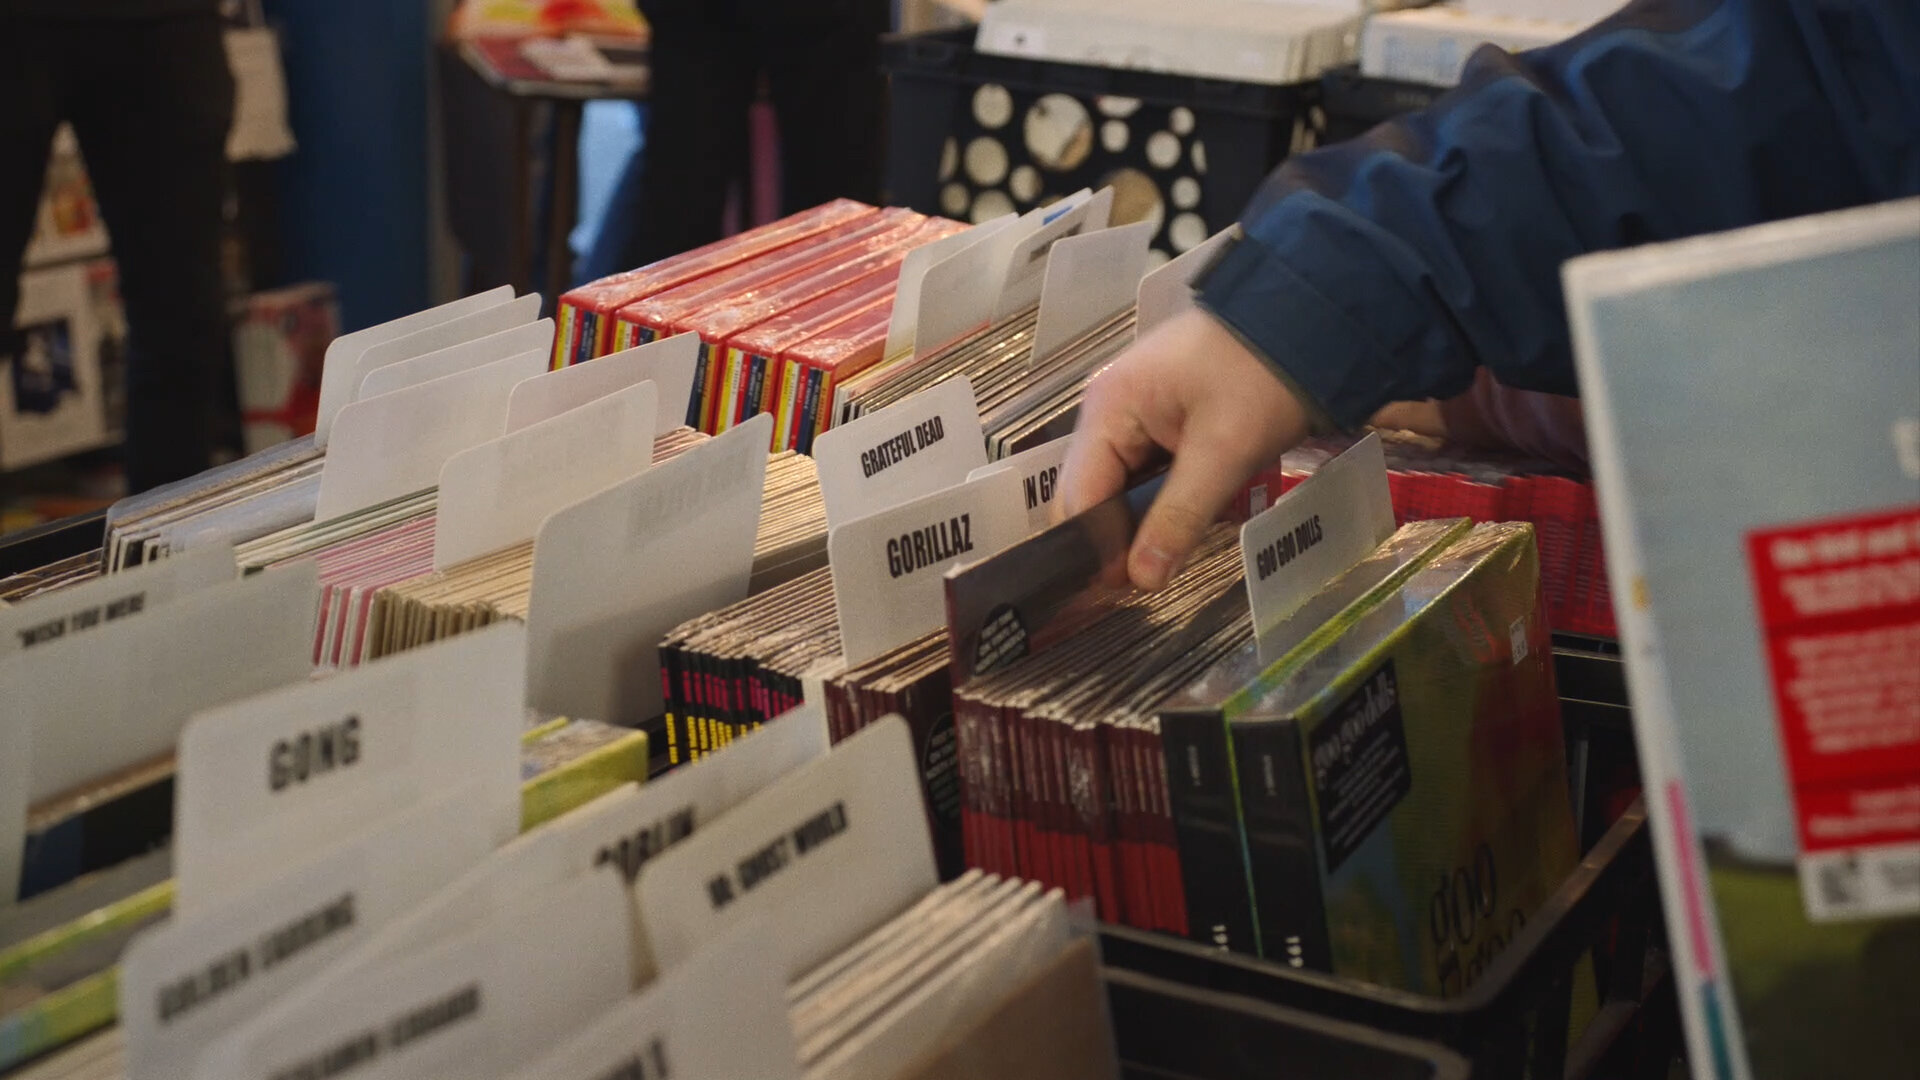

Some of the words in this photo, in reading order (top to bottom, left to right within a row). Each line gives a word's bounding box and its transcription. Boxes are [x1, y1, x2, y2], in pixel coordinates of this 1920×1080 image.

[860, 428, 918, 478] GRATEFUL
[914, 415, 945, 451] DEAD
[886, 512, 974, 579] GORILLAZ
[1256, 543, 1278, 581] GOO
[1276, 531, 1297, 568] GOO
[1295, 514, 1323, 555] DOLLS
[269, 714, 361, 792] GONG
